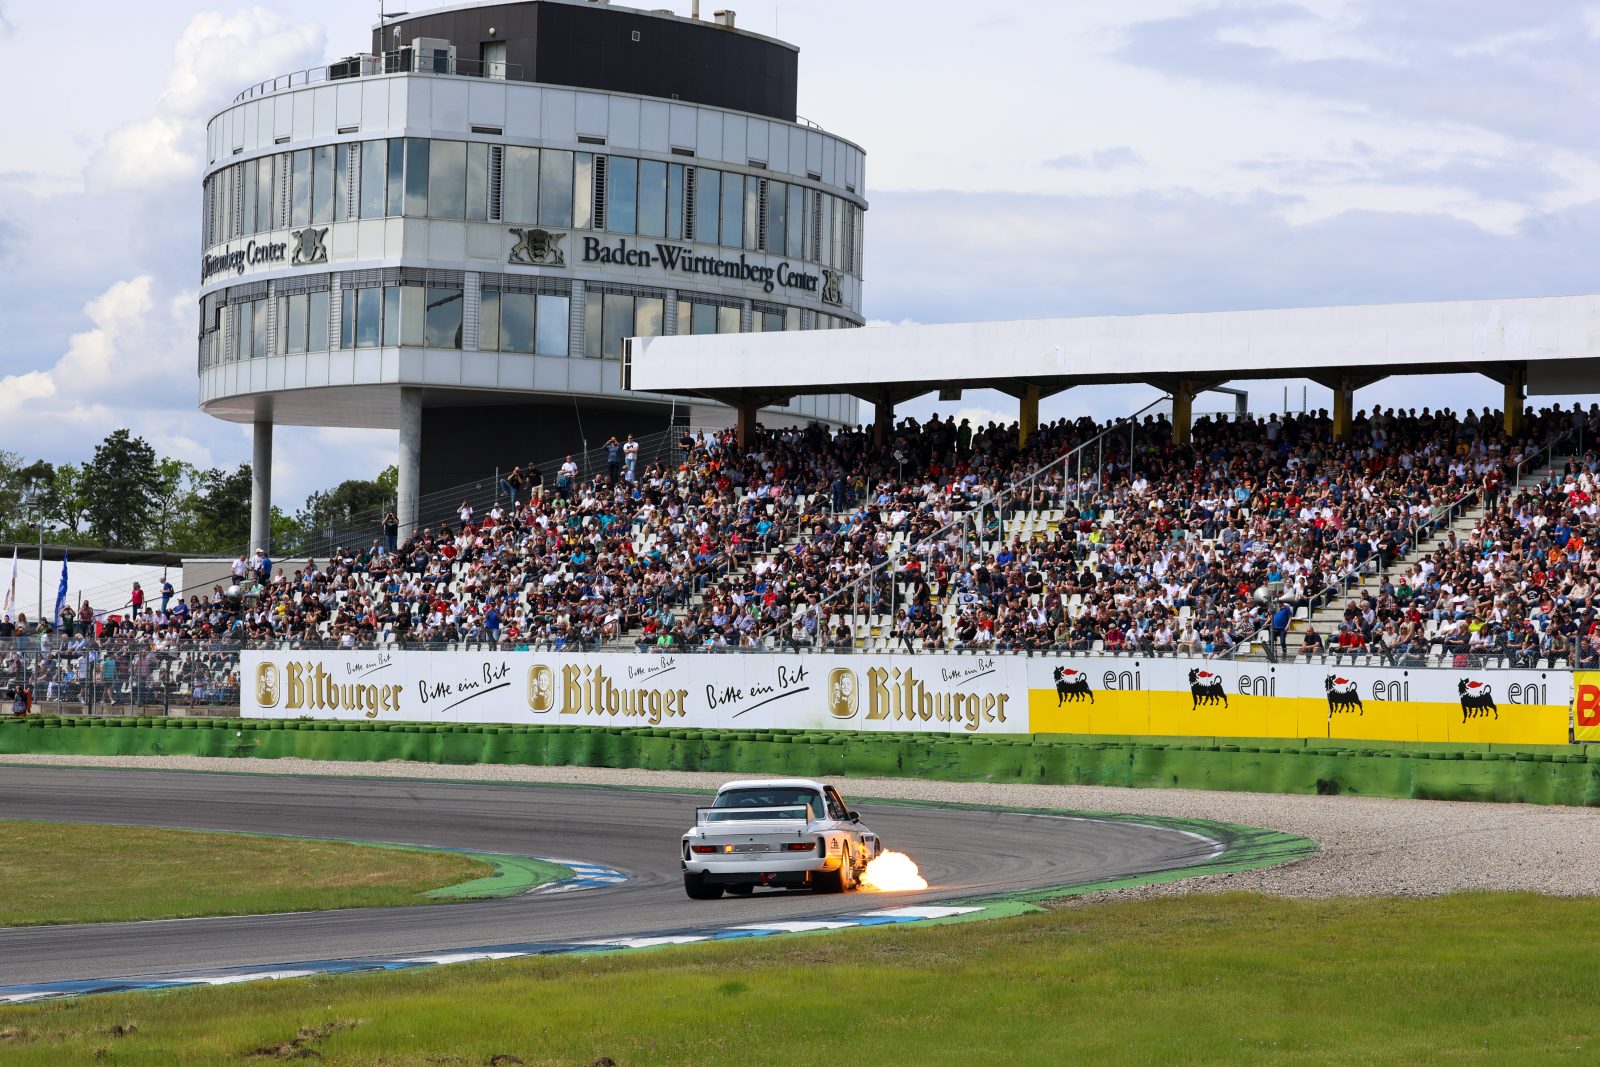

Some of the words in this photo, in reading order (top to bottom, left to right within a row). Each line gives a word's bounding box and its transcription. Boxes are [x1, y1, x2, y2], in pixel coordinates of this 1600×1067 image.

[247, 240, 286, 265] Center
[582, 236, 775, 293] Baden-Württemberg
[776, 262, 819, 292] Center
[346, 662, 364, 675] Bitte
[378, 653, 391, 665] Bit
[628, 665, 645, 679] Bitte
[660, 655, 675, 668] Bit
[941, 668, 961, 682] Bitte
[978, 658, 995, 671] Bit
[1103, 661, 1141, 691] eni
[285, 661, 403, 718] Bitburger
[418, 679, 452, 704] Bitte
[458, 678, 479, 692] ein
[482, 661, 511, 685] Bit
[560, 664, 688, 725] Bitburger
[706, 684, 743, 709] Bitte
[750, 683, 774, 697] ein
[777, 664, 809, 689] Bit
[1238, 666, 1276, 697] eni
[1372, 670, 1409, 702] eni
[1507, 673, 1547, 705] eni
[866, 666, 1009, 731] Bitburger
